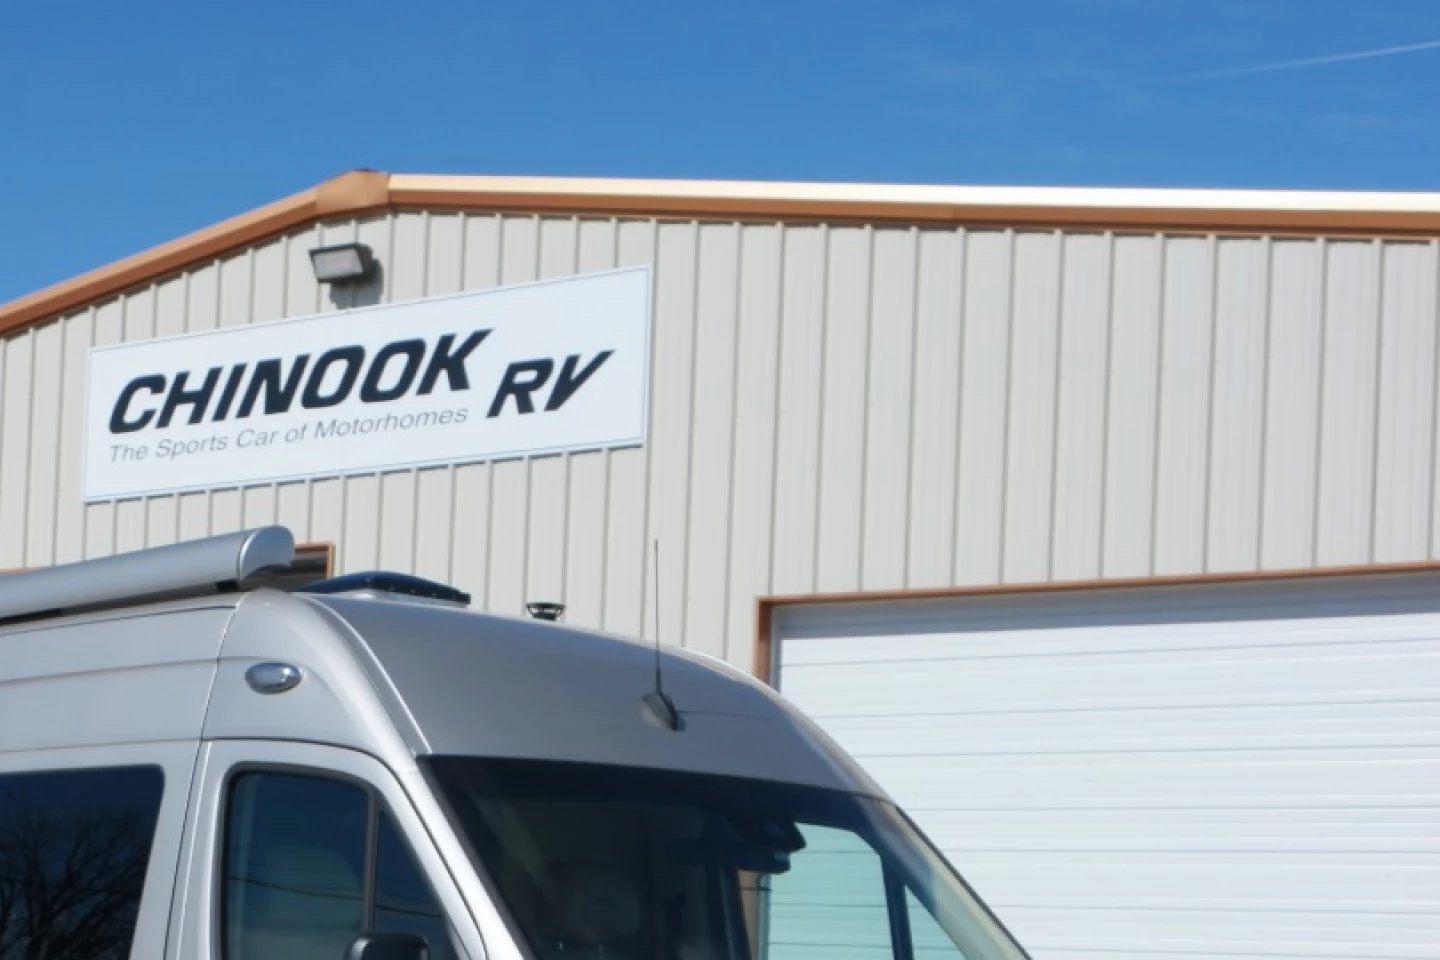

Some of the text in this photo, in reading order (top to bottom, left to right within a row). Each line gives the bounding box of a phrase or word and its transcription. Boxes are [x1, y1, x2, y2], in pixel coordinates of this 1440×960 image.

[109, 328, 615, 434] CHINOOK RV
[110, 407, 468, 463] The Sports Car of Motorhomes
